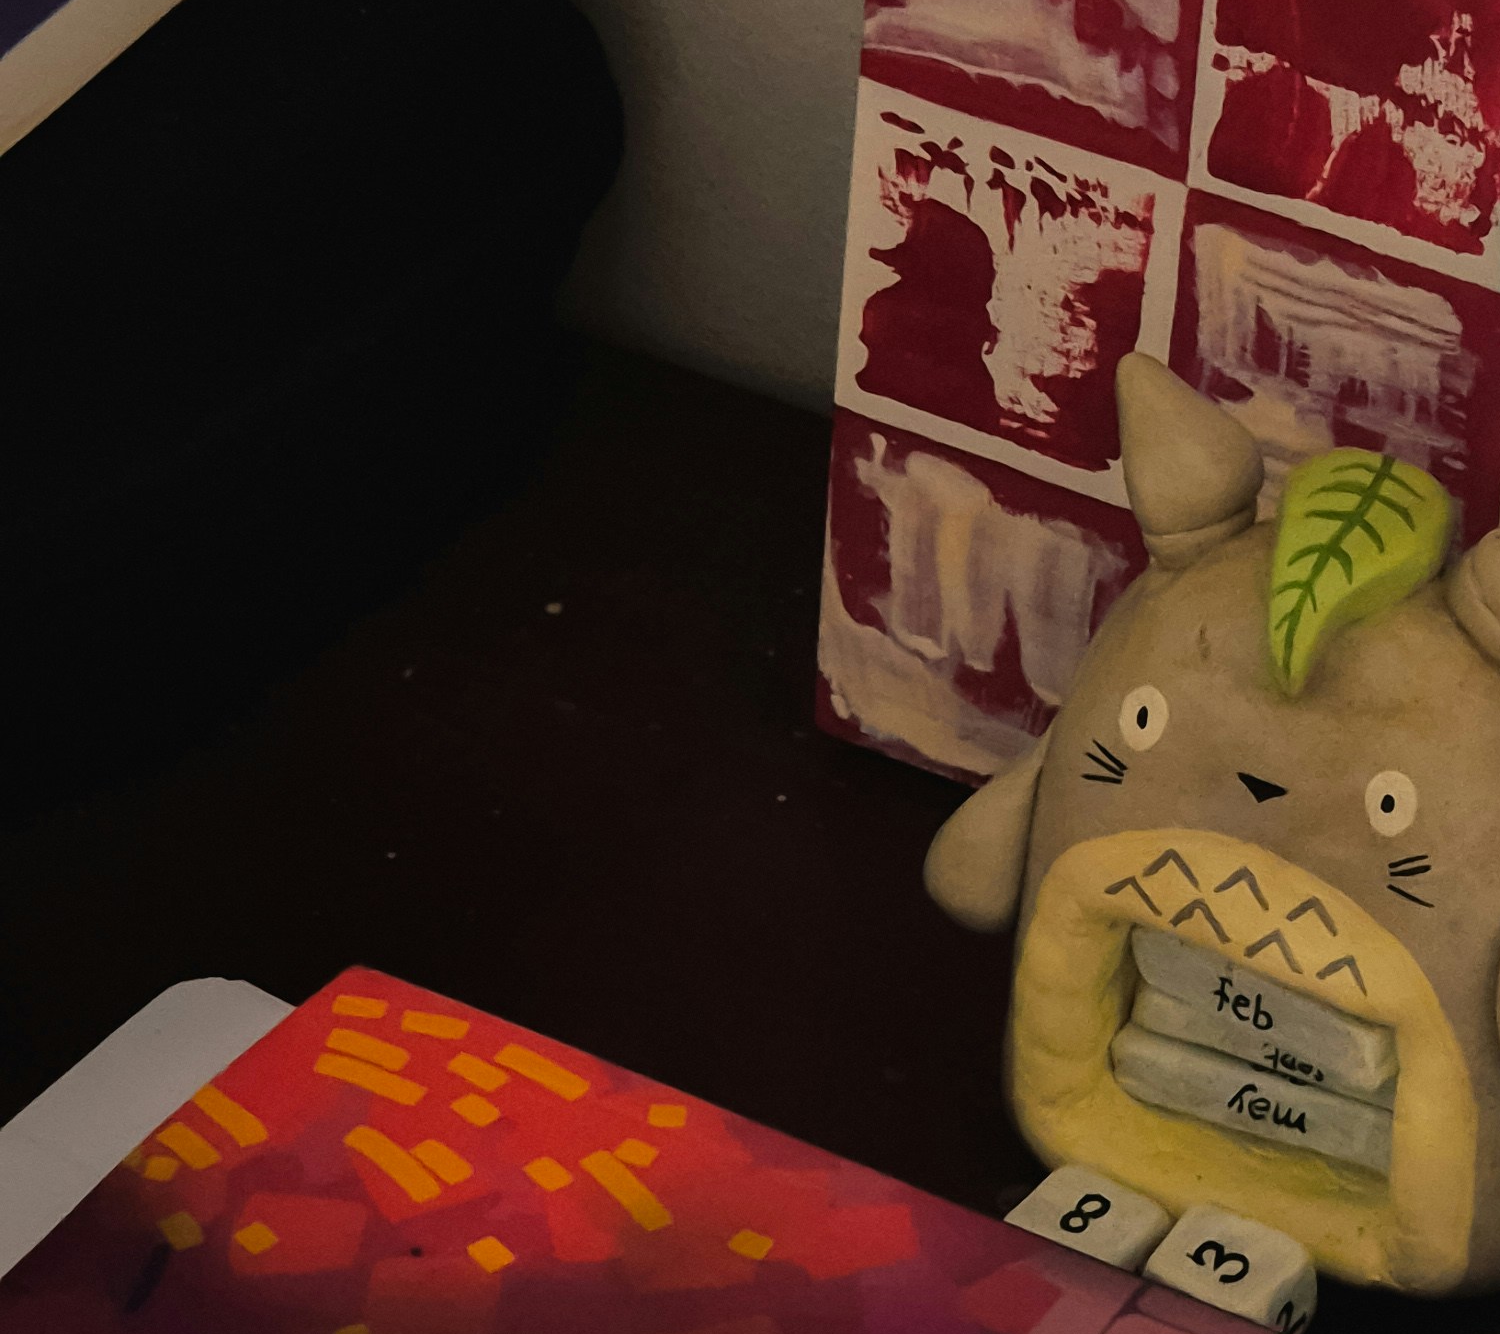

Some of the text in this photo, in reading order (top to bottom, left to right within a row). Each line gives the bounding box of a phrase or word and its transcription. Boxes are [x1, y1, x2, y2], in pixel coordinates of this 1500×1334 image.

[1213, 975, 1274, 1031] feb
[1059, 1193, 1250, 1284] 8 3
